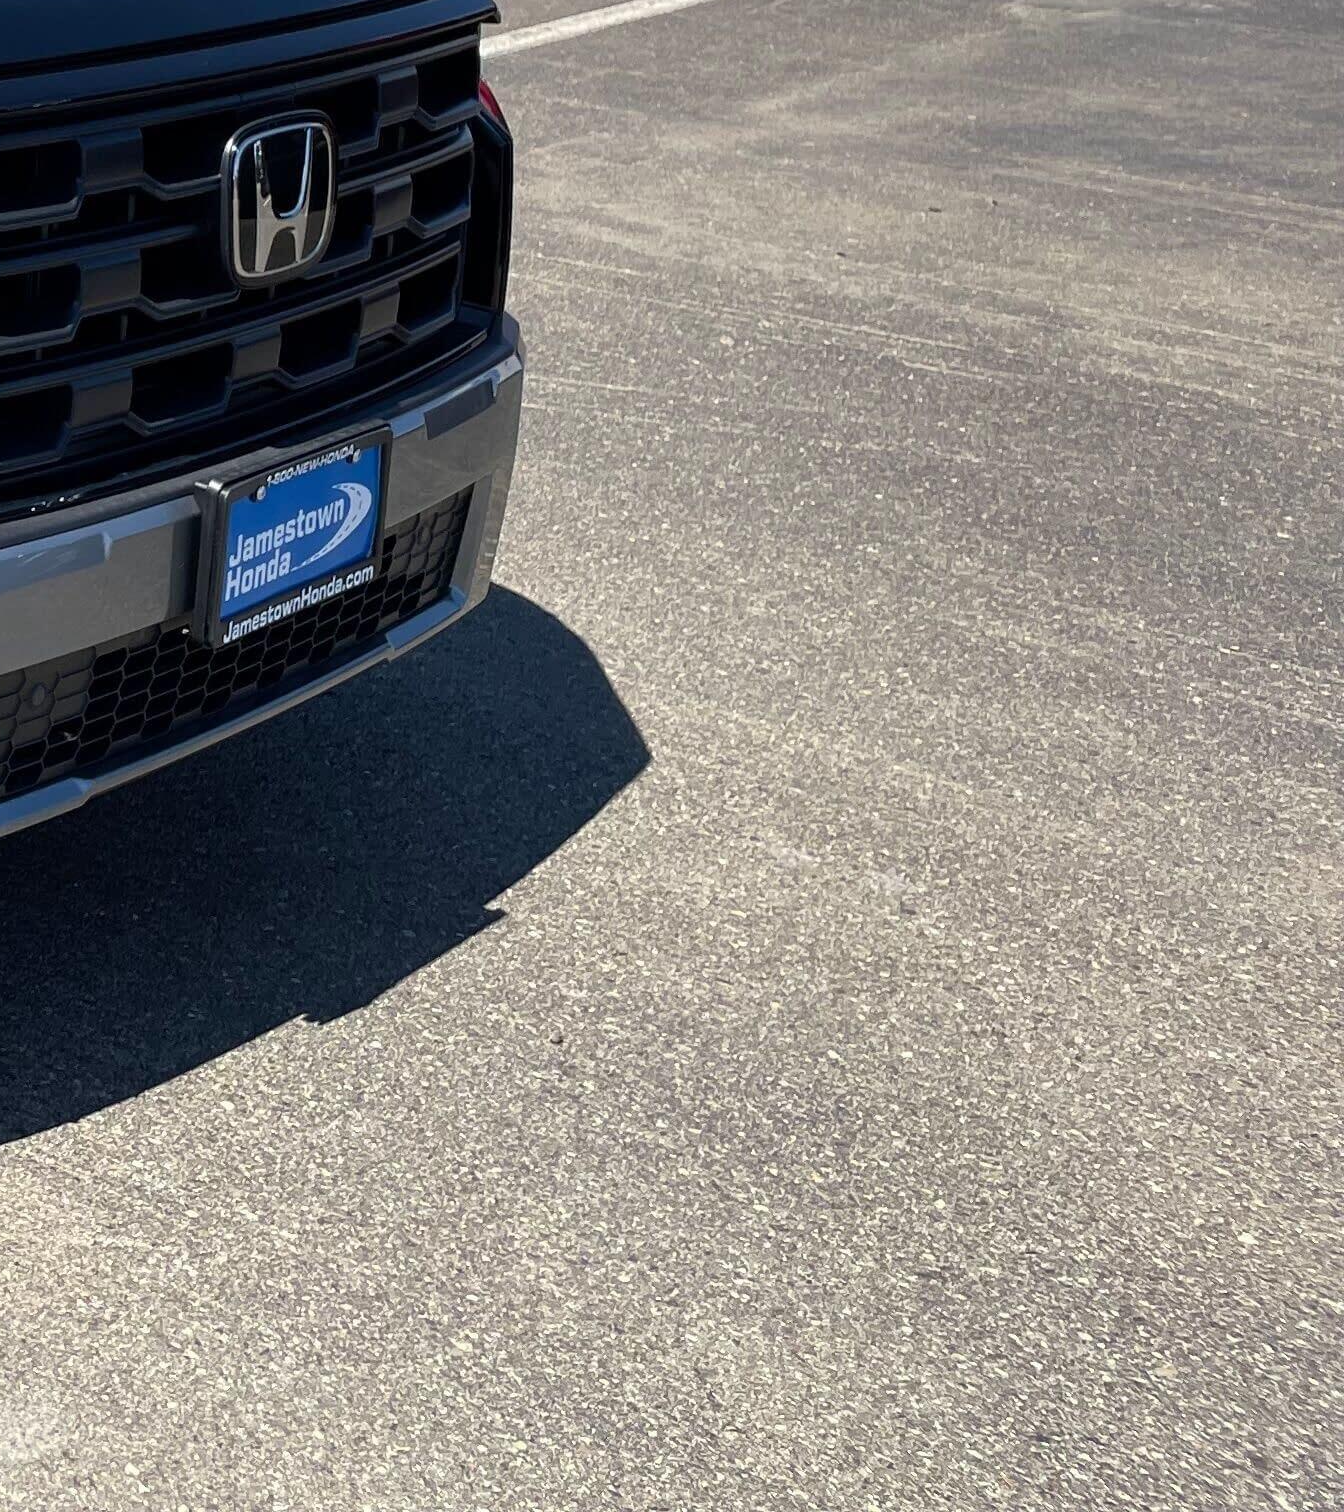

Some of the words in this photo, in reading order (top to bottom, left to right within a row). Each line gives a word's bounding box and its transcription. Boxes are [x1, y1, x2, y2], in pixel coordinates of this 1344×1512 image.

[267, 444, 354, 487] 1-800-NEW-HONDA
[229, 498, 345, 567] Jamestown
[223, 564, 375, 643] JamestownHonda.com
[224, 548, 292, 602] Honda
